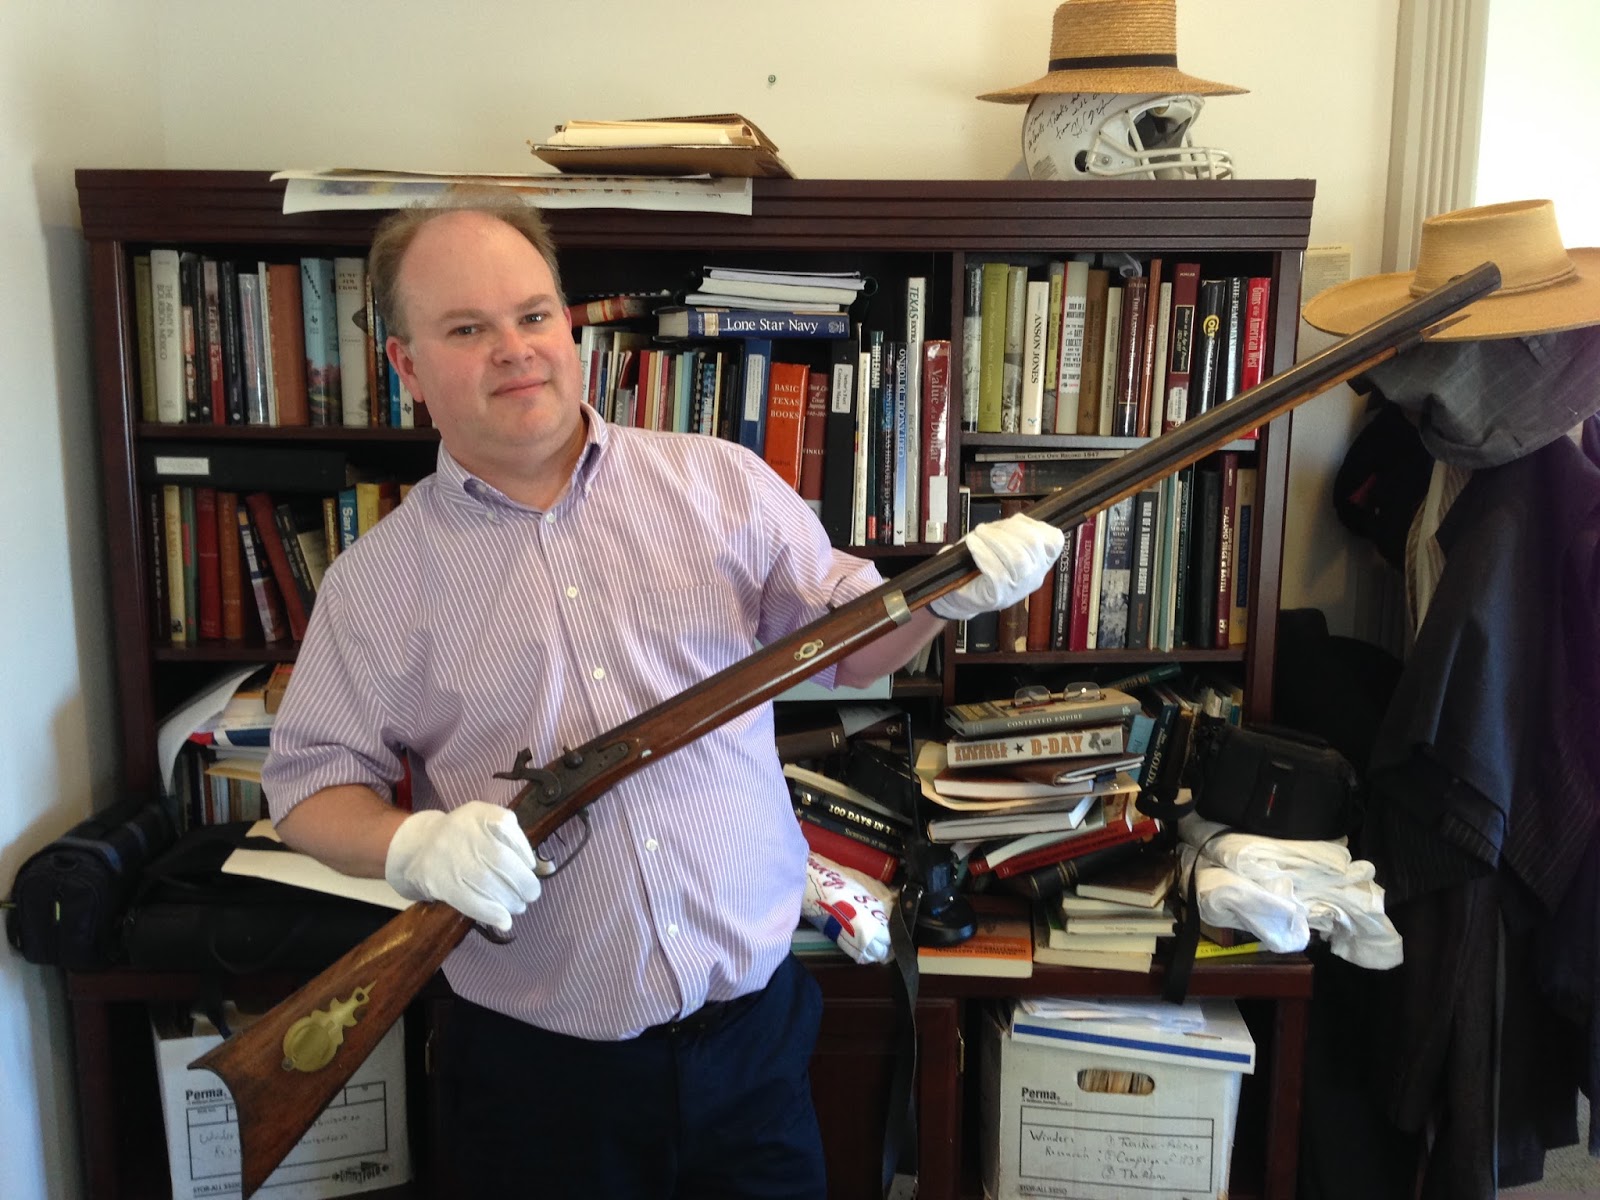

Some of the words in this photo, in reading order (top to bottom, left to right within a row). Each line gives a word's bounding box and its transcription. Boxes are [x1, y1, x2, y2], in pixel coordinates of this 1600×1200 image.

[909, 287, 920, 319] TEXAS
[1251, 287, 1264, 305] Guns
[726, 317, 755, 331] Lone
[759, 319, 785, 331] Star
[789, 319, 818, 334] Navy
[1032, 313, 1042, 349] ANSON
[1248, 318, 1262, 350] American
[871, 345, 881, 388] RIFLEMAN
[1031, 351, 1040, 383] JONES
[1247, 352, 1260, 368] West
[774, 383, 799, 393] BASIC
[931, 369, 943, 404] Value
[770, 410, 800, 419] BOOKS
[773, 397, 801, 406] TEXAS
[930, 421, 940, 462] Dollar
[343, 507, 354, 531] San
[1142, 518, 1151, 526] OF
[1143, 501, 1152, 517] WAR
[1082, 540, 1091, 572] EDWARD
[1139, 533, 1150, 566] THOUSAND
[1081, 574, 1090, 614] BURLESON
[1138, 568, 1148, 595] DESERTS
[1007, 717, 1052, 728] CONTESTED
[1054, 713, 1083, 723] EMPIRE
[1030, 735, 1084, 756] D-DAY
[828, 804, 846, 816] 100
[847, 811, 872, 827] DAYS
[873, 820, 884, 831] IN
